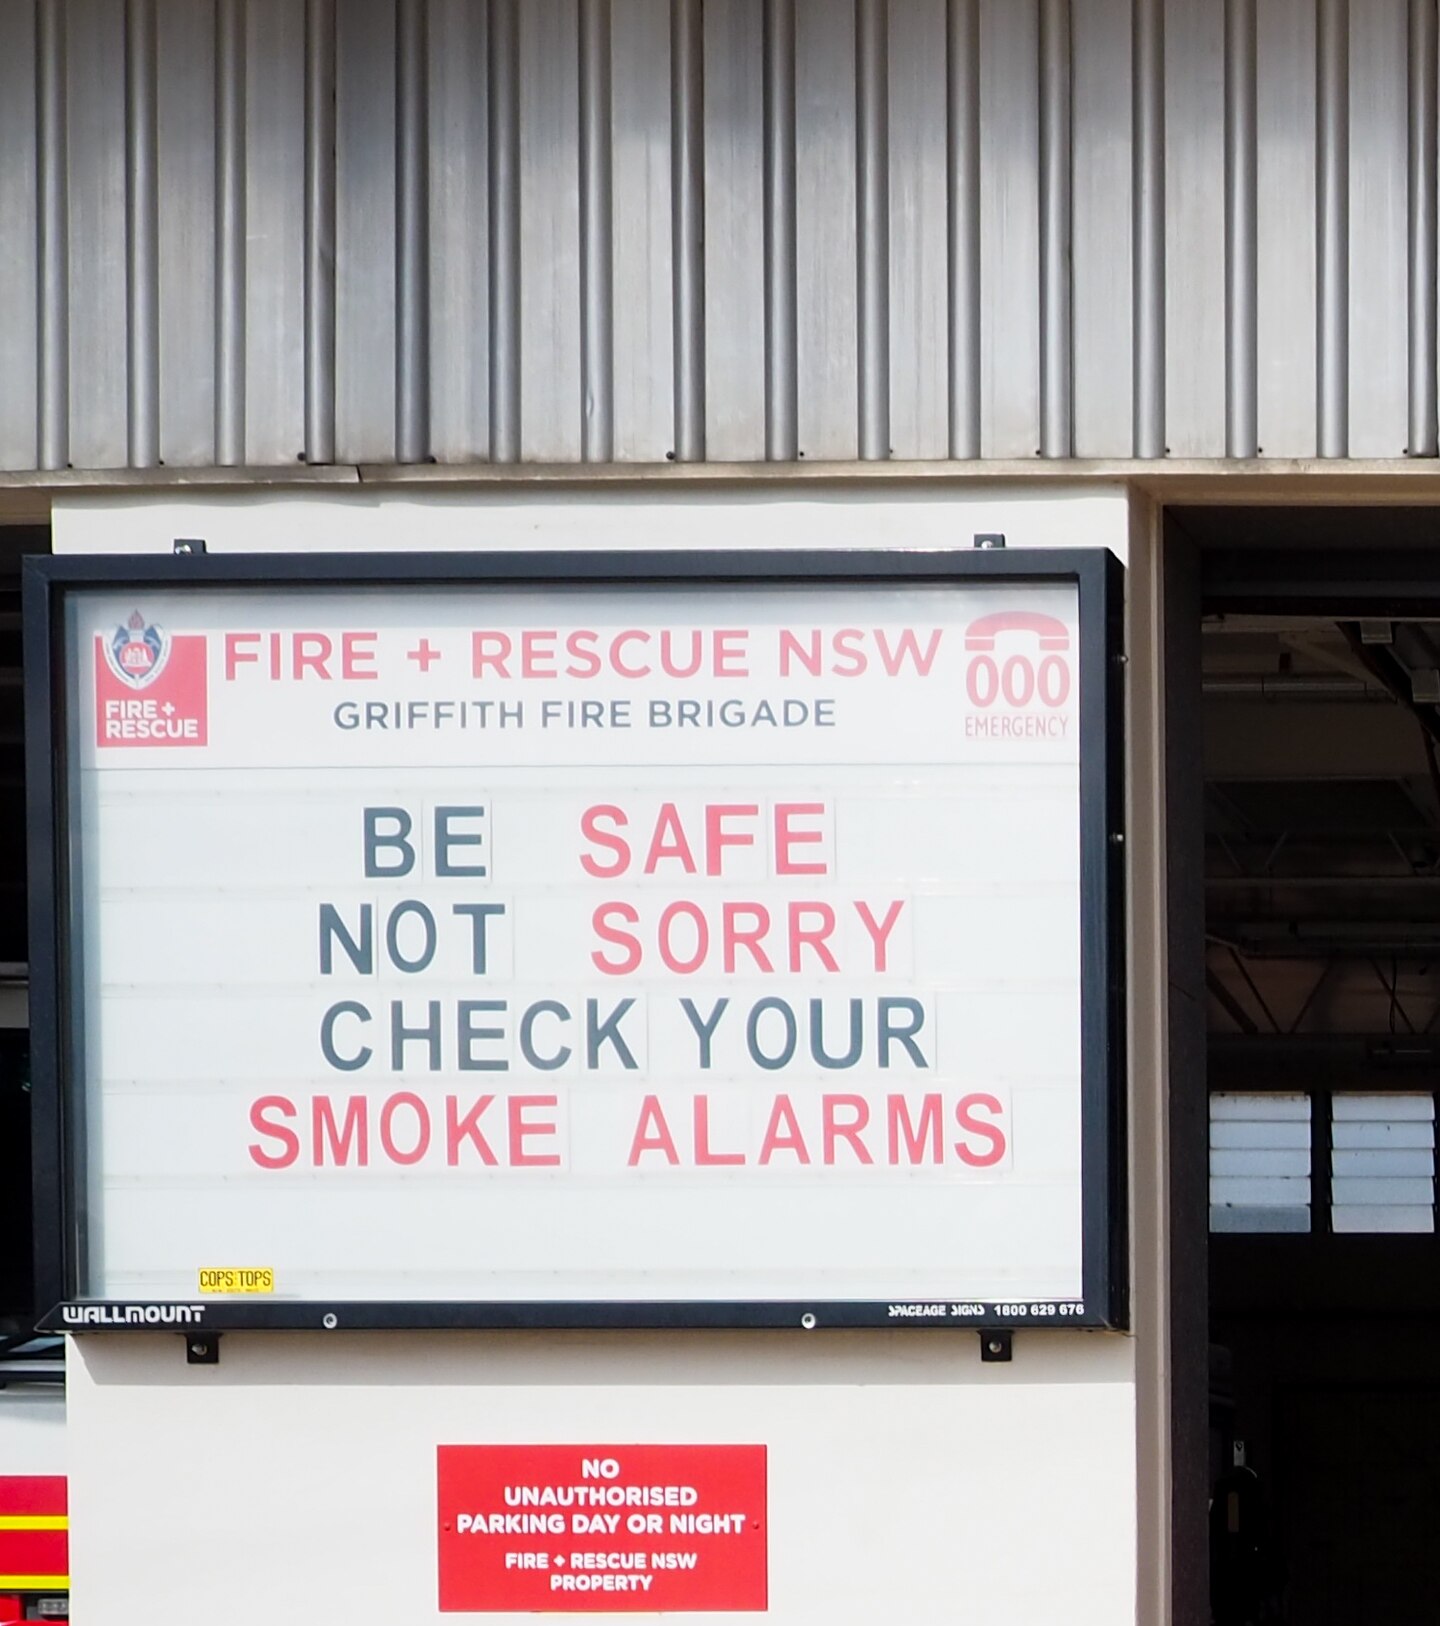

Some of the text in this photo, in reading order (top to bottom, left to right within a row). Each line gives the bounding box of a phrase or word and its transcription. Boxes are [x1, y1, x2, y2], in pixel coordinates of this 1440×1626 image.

[225, 632, 378, 681] FIRE
[407, 639, 441, 672] +
[472, 629, 750, 681] RESCUE
[779, 628, 943, 678] NSW
[966, 654, 1071, 708] 000
[105, 700, 157, 719] FIRE
[334, 700, 836, 730] GRIFFITH FIRE BRIGADE
[105, 719, 199, 739] RESCUE
[965, 715, 1068, 737] EMERGENCY
[363, 803, 828, 878] BE SAFE
[319, 900, 905, 975] NOT SORRY
[321, 997, 928, 1072] CHECK YOUR
[248, 1092, 1007, 1169] SMOKE ALARMS
[200, 1270, 271, 1287] COPS TOPS
[62, 1305, 205, 1324] WALLMOUNT
[888, 1303, 1084, 1317] SPACEAGE SIGNS 1800 629 676
[581, 1458, 620, 1479] NO
[504, 1486, 698, 1507] UNAUTHORISED
[457, 1513, 746, 1535] PARKING DAY OR NIGHT
[505, 1552, 549, 1569] FIRE
[570, 1552, 647, 1569] RESCUE
[651, 1552, 698, 1569] NSW
[550, 1575, 653, 1591] PROPERTY
